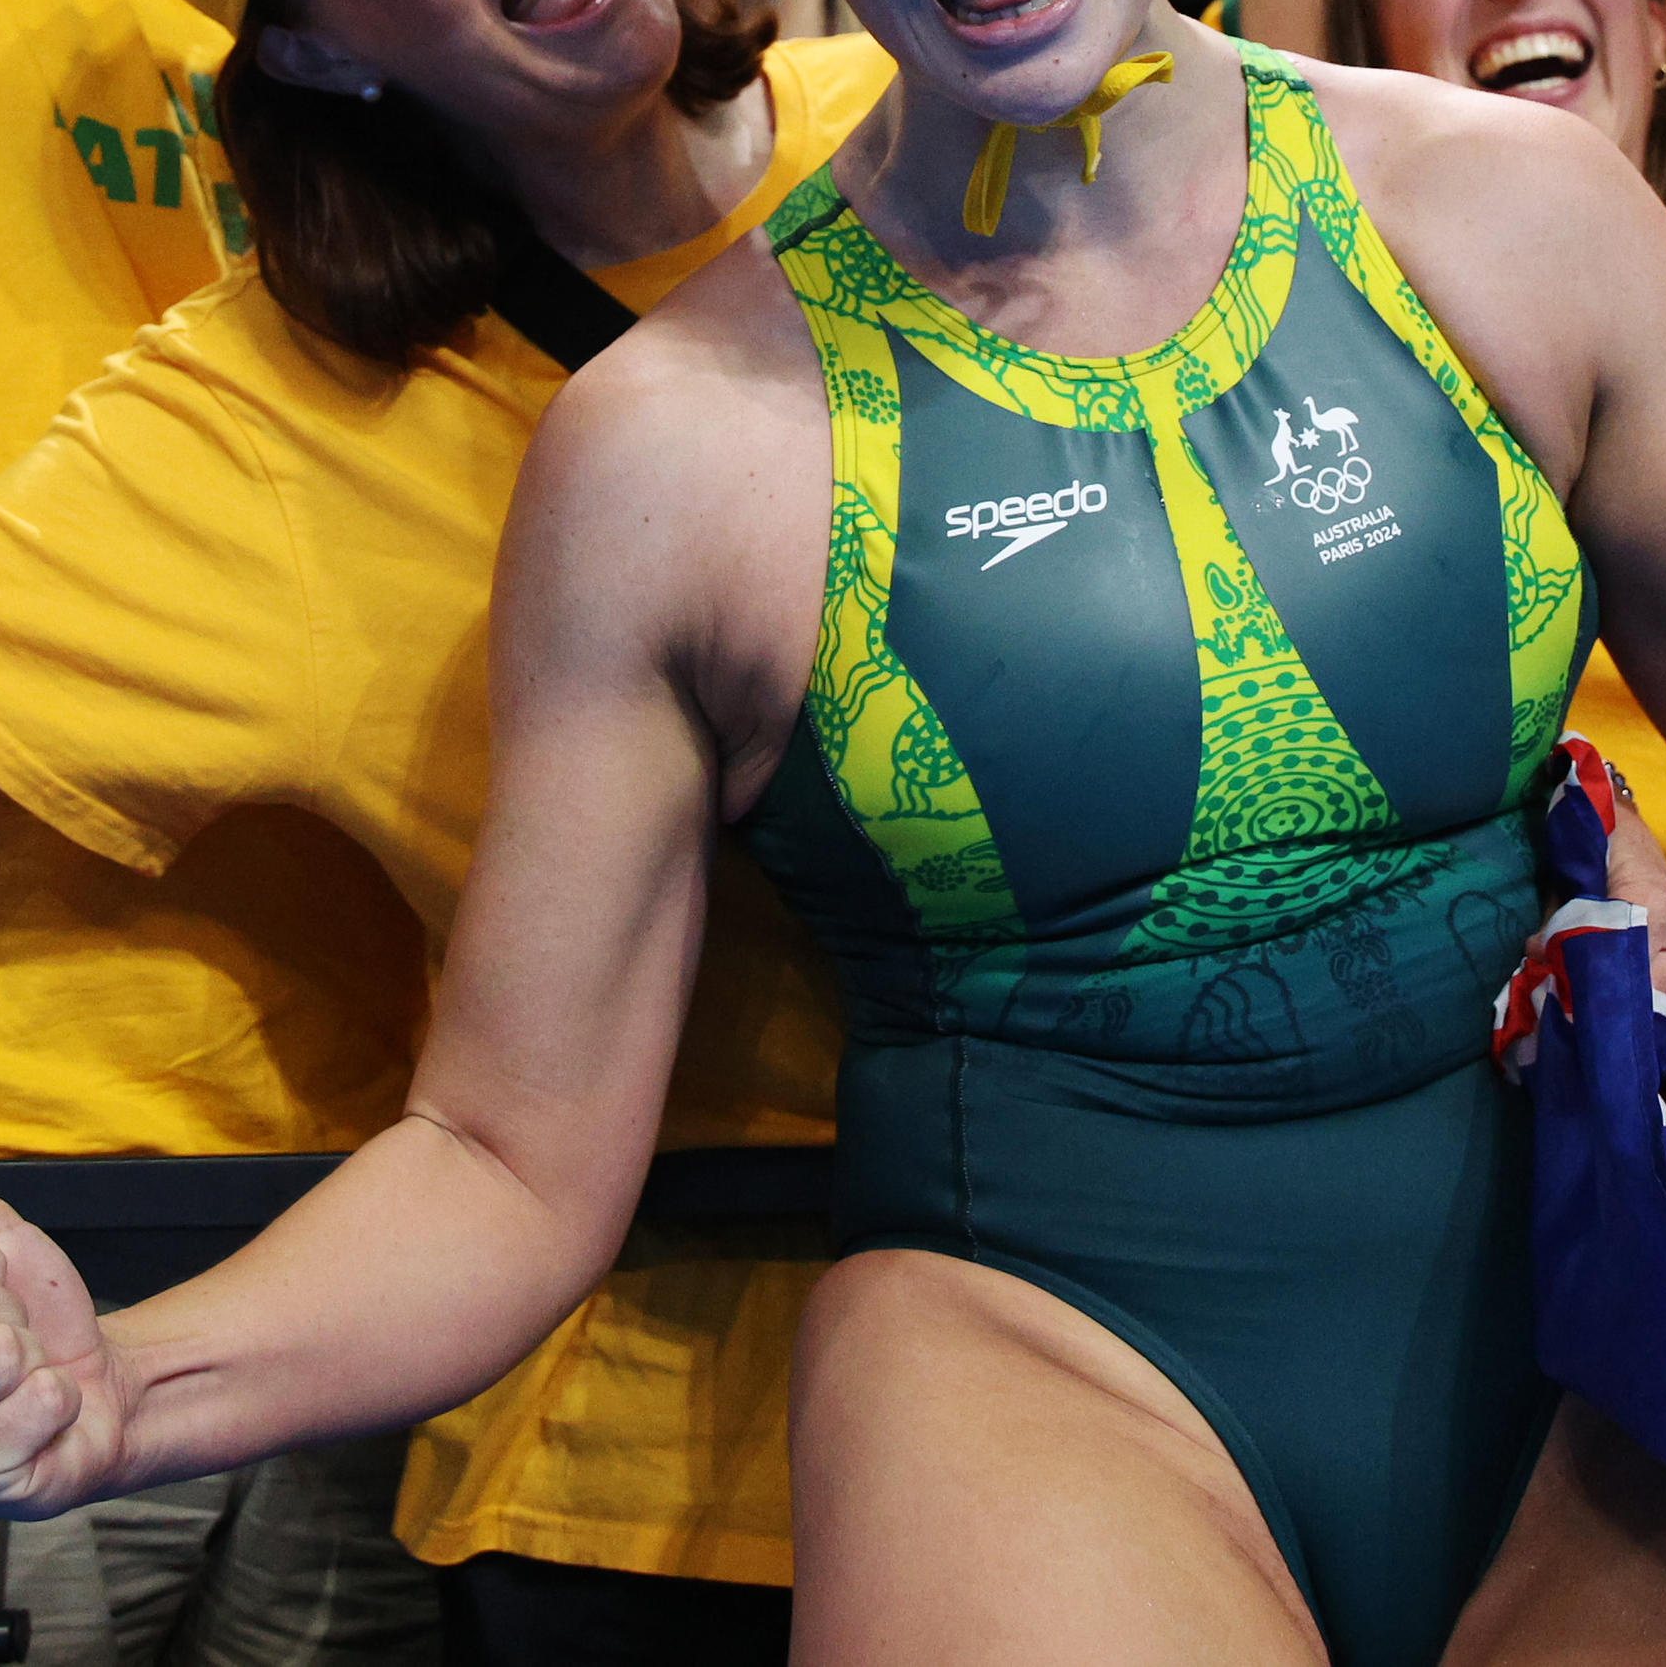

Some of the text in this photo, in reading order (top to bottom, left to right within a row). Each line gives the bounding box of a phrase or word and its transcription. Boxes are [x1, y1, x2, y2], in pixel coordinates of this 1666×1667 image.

[945, 479, 1107, 539] speedo
[1313, 505, 1395, 548] AUSTRALIA
[1319, 522, 1402, 566] PARIS 2024
